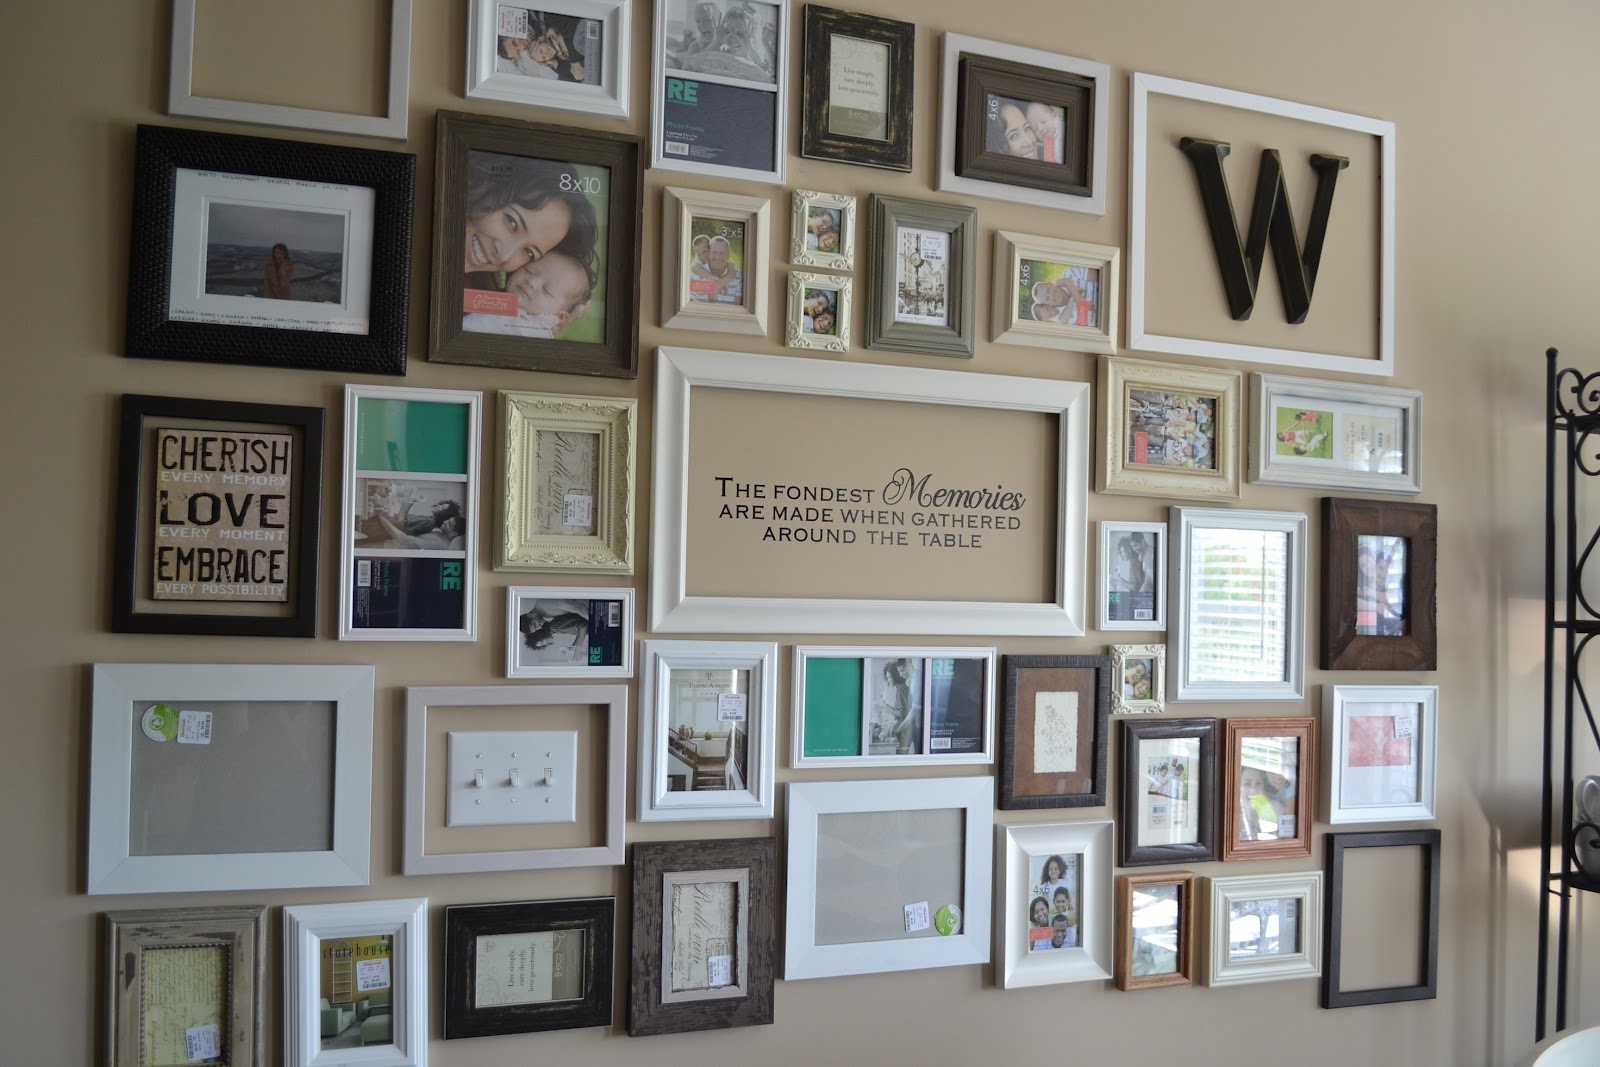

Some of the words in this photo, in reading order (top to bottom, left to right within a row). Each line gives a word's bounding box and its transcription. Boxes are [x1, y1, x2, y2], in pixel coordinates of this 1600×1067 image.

[668, 79, 698, 102] RE
[850, 88, 880, 98] generously.
[856, 79, 875, 88] deeply,
[560, 174, 600, 194] 8x10
[1180, 137, 1349, 324] W
[1021, 265, 1030, 285] 4x6
[162, 435, 289, 474] CHERISH
[161, 472, 213, 483] EVERY
[223, 474, 288, 486] MEMORY
[774, 484, 875, 503] FONDEST
[882, 467, 1026, 510] Memories
[160, 490, 286, 528] LOVE
[719, 504, 764, 520] ARE
[772, 507, 834, 523] MADE
[840, 509, 905, 525] WHEN
[911, 512, 1021, 530] GATHERED
[160, 527, 210, 538] EVERY
[220, 530, 285, 541] MOMENT
[763, 526, 856, 544] AROUND
[867, 530, 908, 546] THE
[918, 533, 982, 548] TABLE
[158, 546, 285, 584] EMBRACE
[442, 562, 462, 590] RE
[156, 583, 196, 594] EVERY
[202, 585, 284, 595] POSSIBILITY
[1109, 593, 1120, 602] RE
[590, 647, 600, 663] RE
[932, 659, 954, 676] RE
[1033, 885, 1050, 894] 4x6
[323, 943, 390, 959] storehouse
